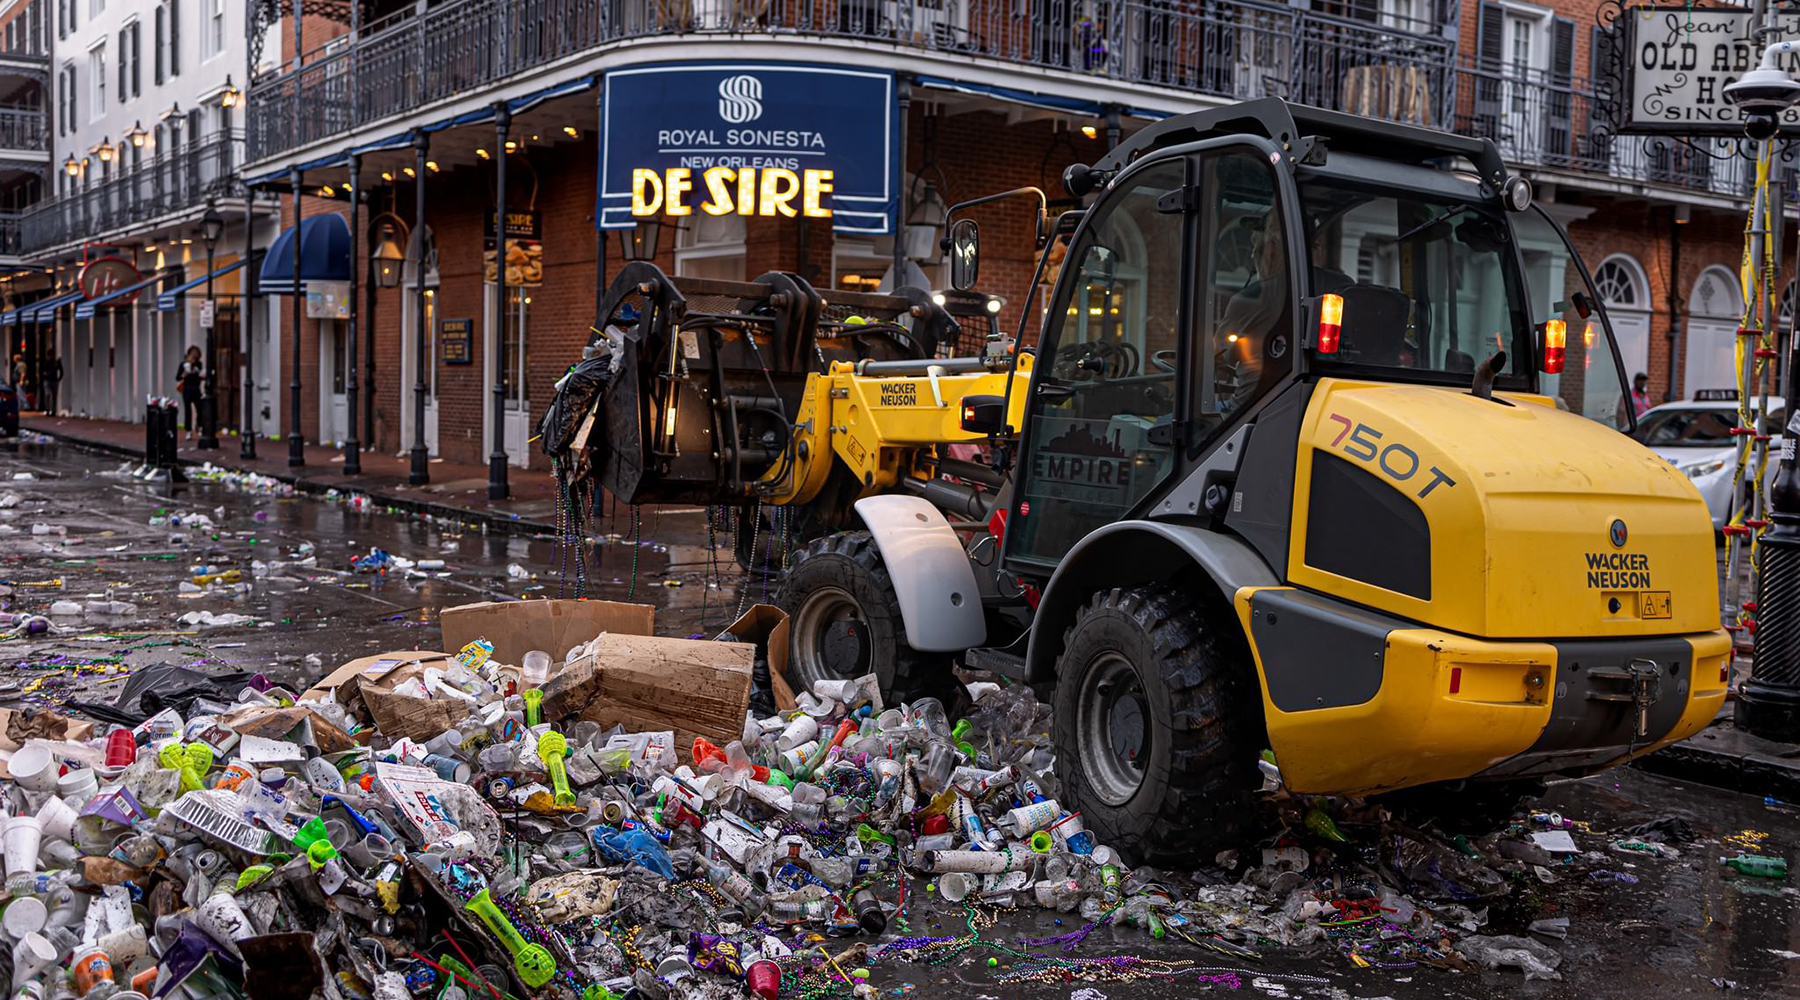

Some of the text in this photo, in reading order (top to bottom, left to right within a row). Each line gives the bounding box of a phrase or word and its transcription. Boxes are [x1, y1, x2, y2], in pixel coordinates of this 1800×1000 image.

[1641, 41, 1697, 71] OLD
[658, 130, 825, 148] ROYAL SONESTA
[680, 156, 799, 170] NEW ORLEANS
[881, 383, 916, 394] WACKER
[881, 395, 916, 406] NEUSON
[1032, 454, 1132, 486] EMPIRE
[1585, 553, 1649, 570] WACKER
[1587, 571, 1650, 588] NEUSON
